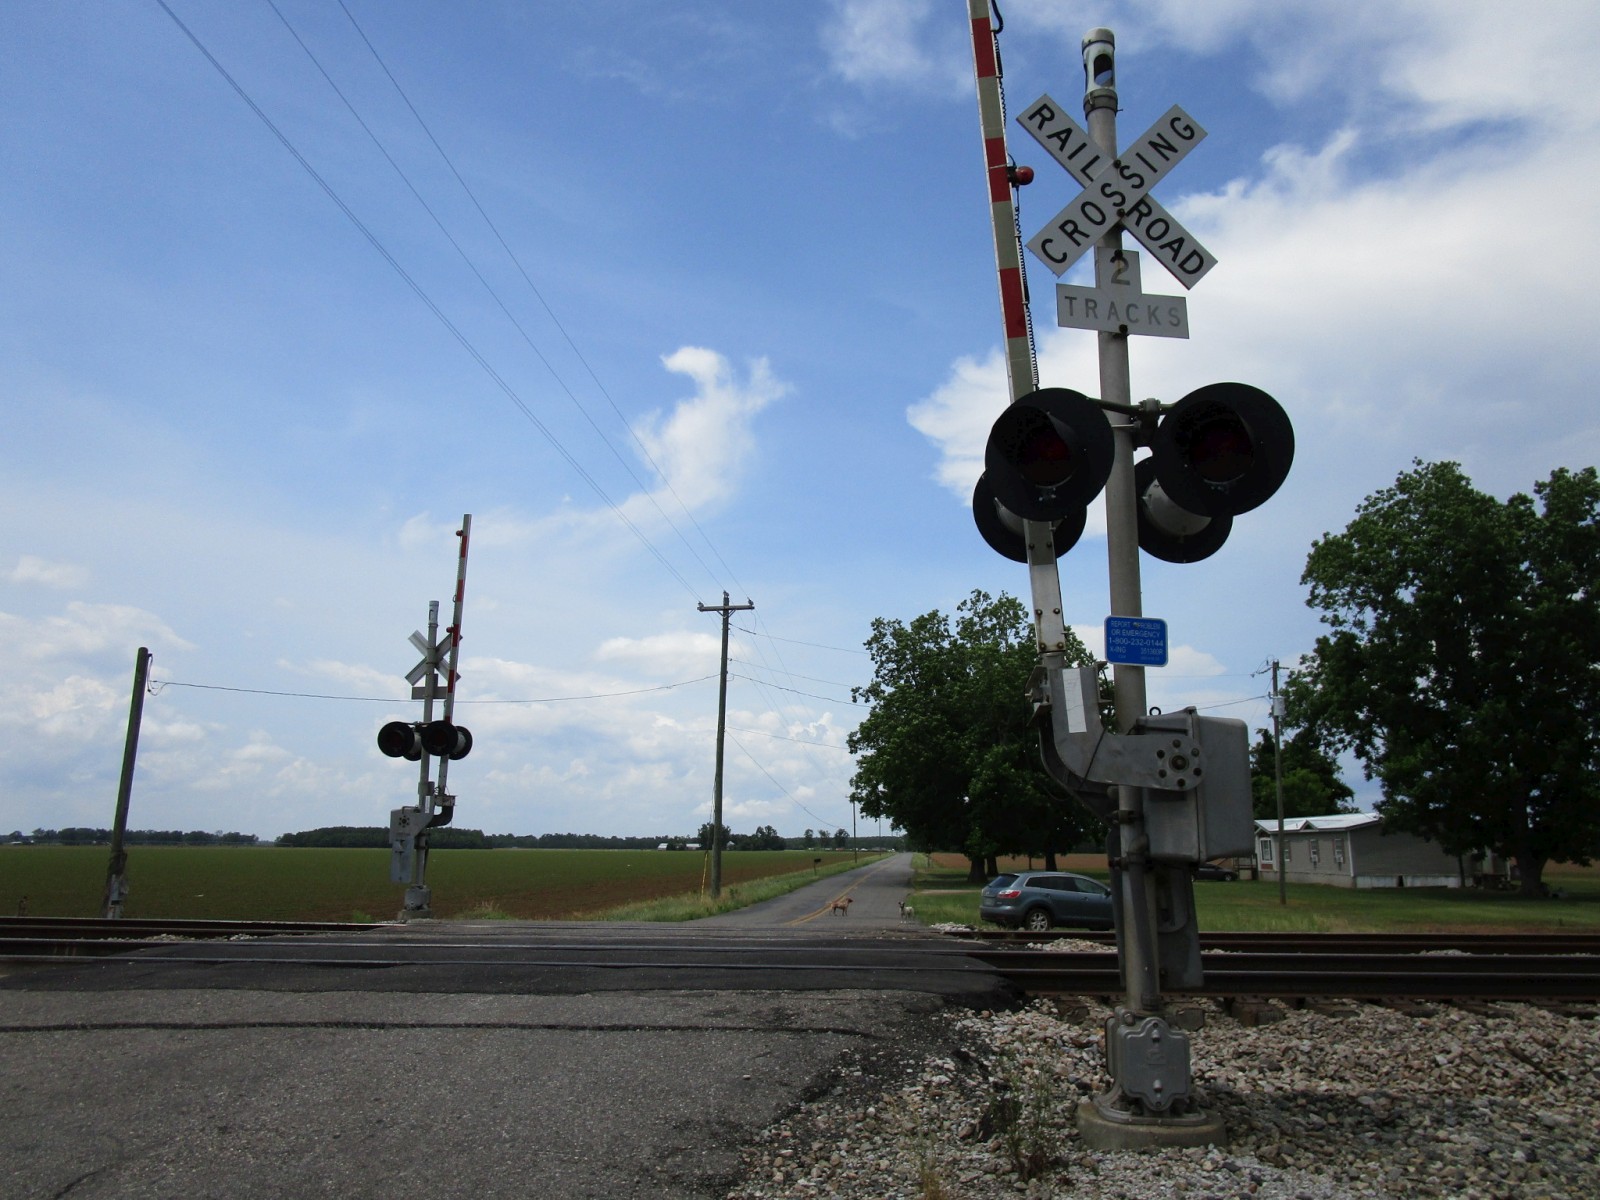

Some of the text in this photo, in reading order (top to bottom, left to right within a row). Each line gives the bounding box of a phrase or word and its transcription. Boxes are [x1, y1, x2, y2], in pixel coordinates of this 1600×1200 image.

[1028, 103, 1204, 275] RAIL ROAD
[1041, 116, 1196, 264] CROSSING
[1110, 255, 1131, 286] 2
[1064, 295, 1181, 327] TRACKS
[1109, 637, 1163, 646] 1-800-232-0144
[1122, 629, 1160, 637] EMERGENCY
